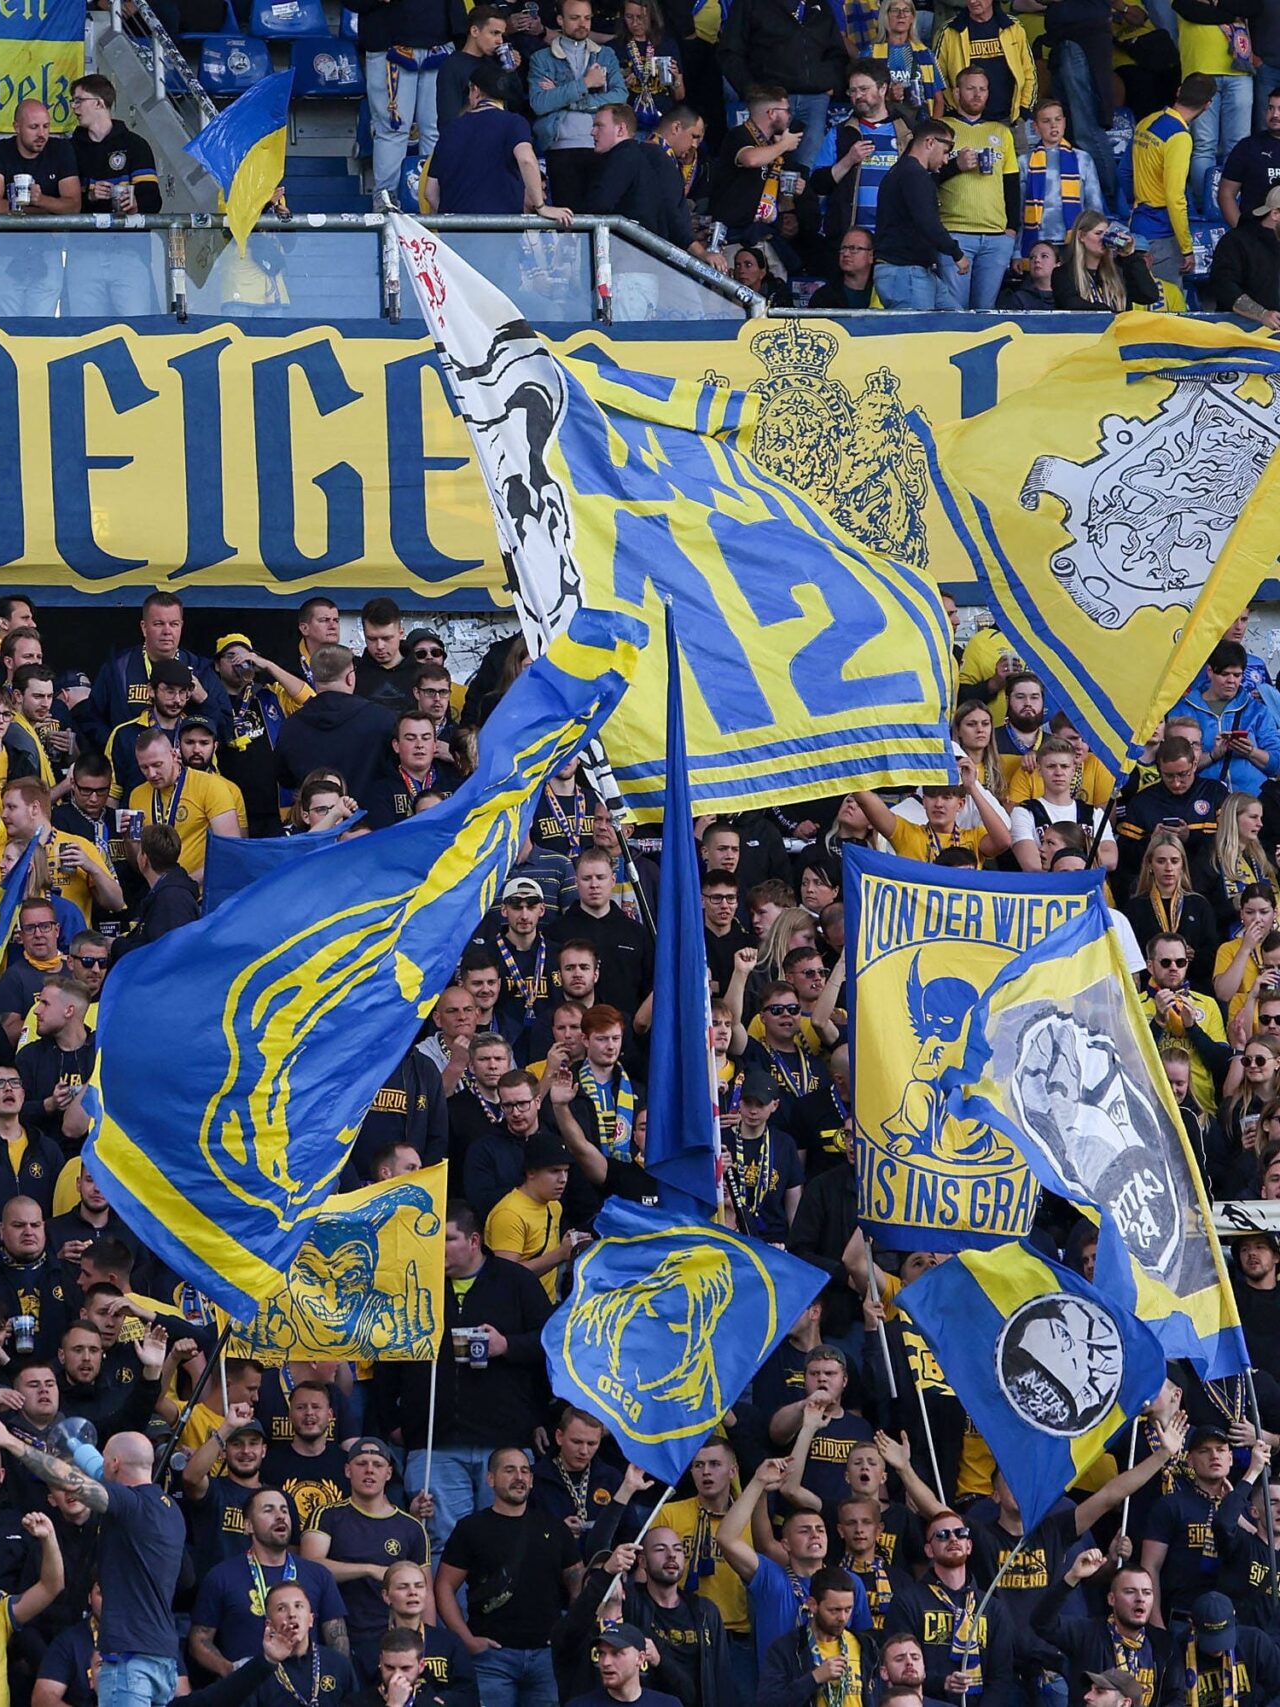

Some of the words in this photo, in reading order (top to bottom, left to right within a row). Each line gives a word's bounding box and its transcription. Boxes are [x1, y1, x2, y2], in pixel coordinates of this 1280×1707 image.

[864, 879, 919, 960] VON
[925, 892, 983, 940] DER
[905, 1168, 961, 1228] INS
